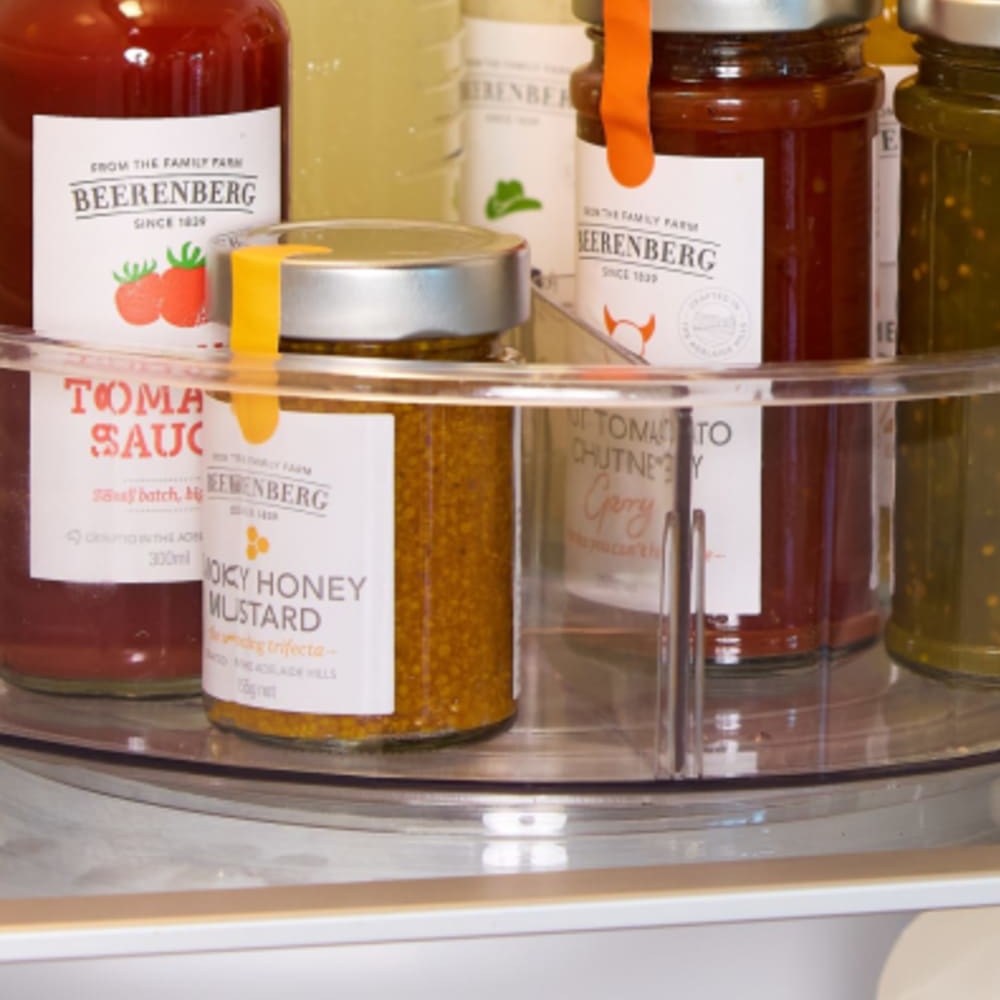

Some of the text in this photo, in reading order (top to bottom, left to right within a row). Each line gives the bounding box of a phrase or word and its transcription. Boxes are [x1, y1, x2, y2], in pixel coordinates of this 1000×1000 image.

[90, 157, 243, 173] FROM THE FAMILY FARM
[71, 180, 257, 213] BEERENBERG
[134, 218, 173, 230] SINCE
[622, 210, 660, 226] FAMILY
[664, 218, 699, 232] FARM
[601, 266, 630, 280] SINCE
[256, 569, 368, 601] HONEY
[208, 590, 322, 632] MUSTARD
